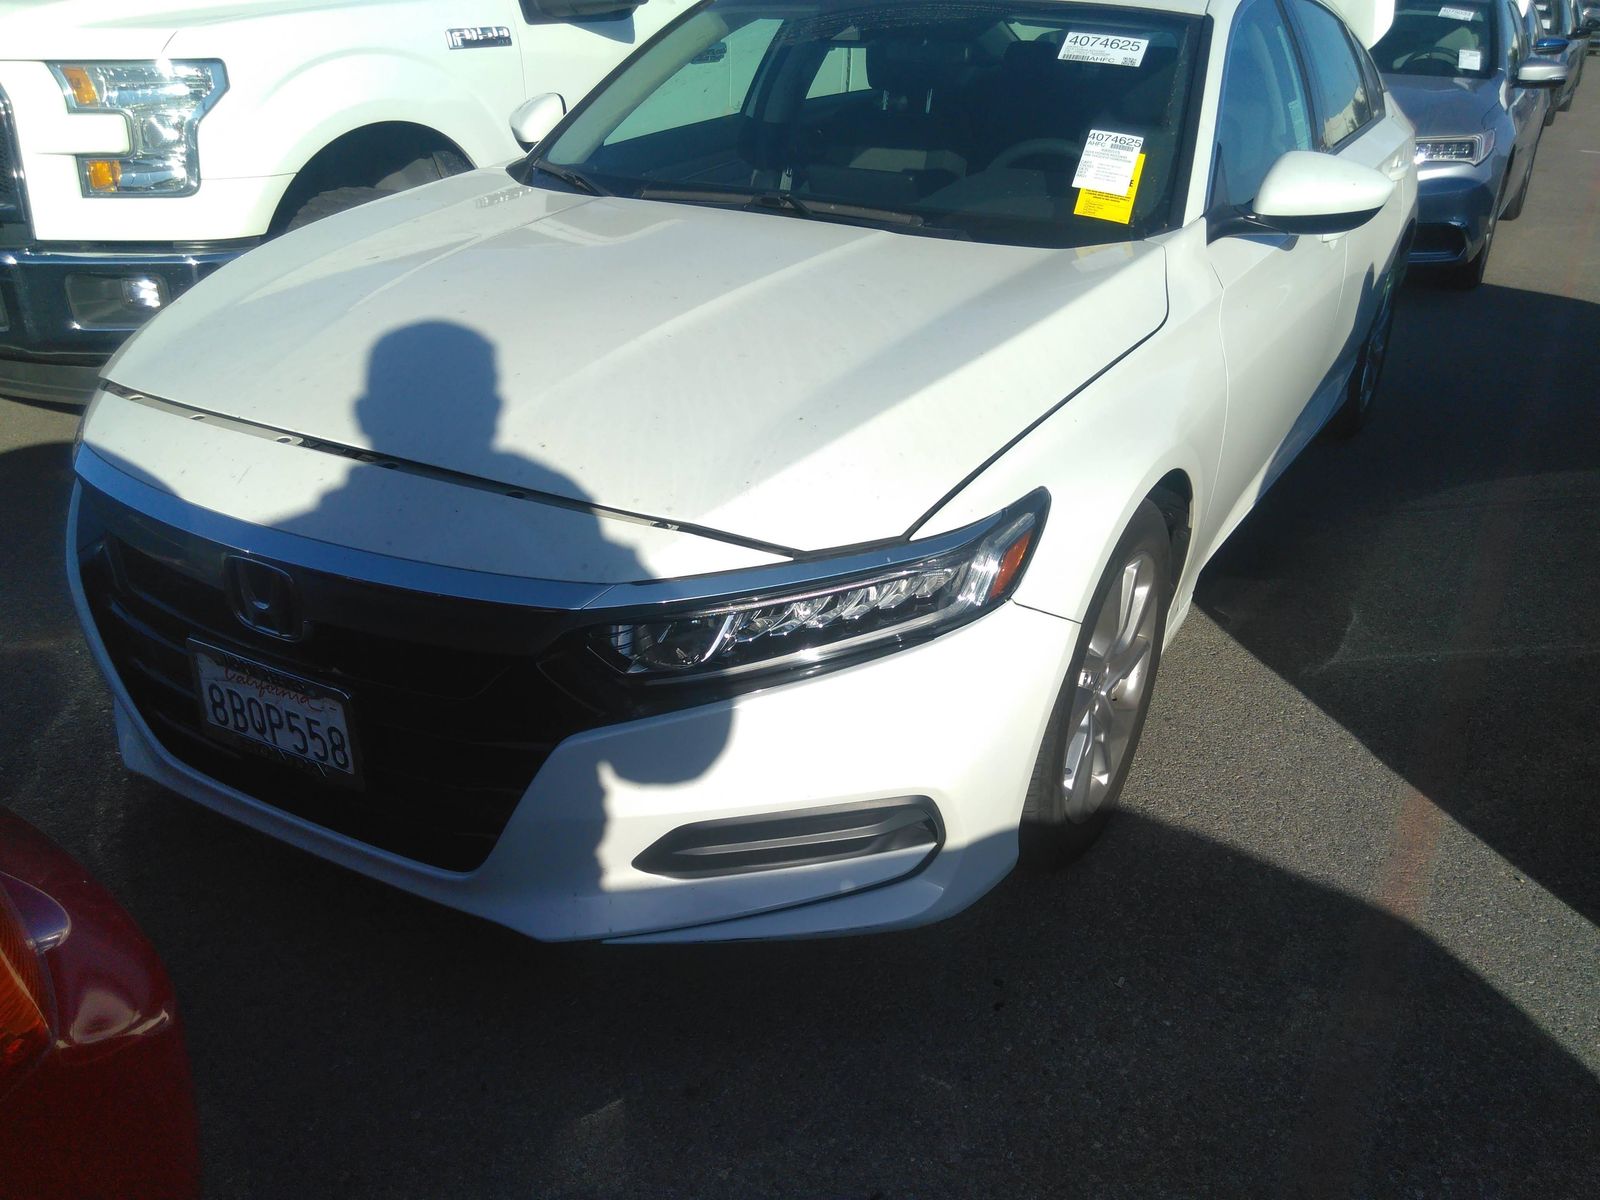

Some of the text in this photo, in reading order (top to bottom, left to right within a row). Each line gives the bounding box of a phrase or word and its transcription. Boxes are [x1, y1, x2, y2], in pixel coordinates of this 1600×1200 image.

[1069, 35, 1141, 52] 4074625
[1088, 132, 1142, 148] 4074625
[208, 683, 349, 769] 8BQP558
